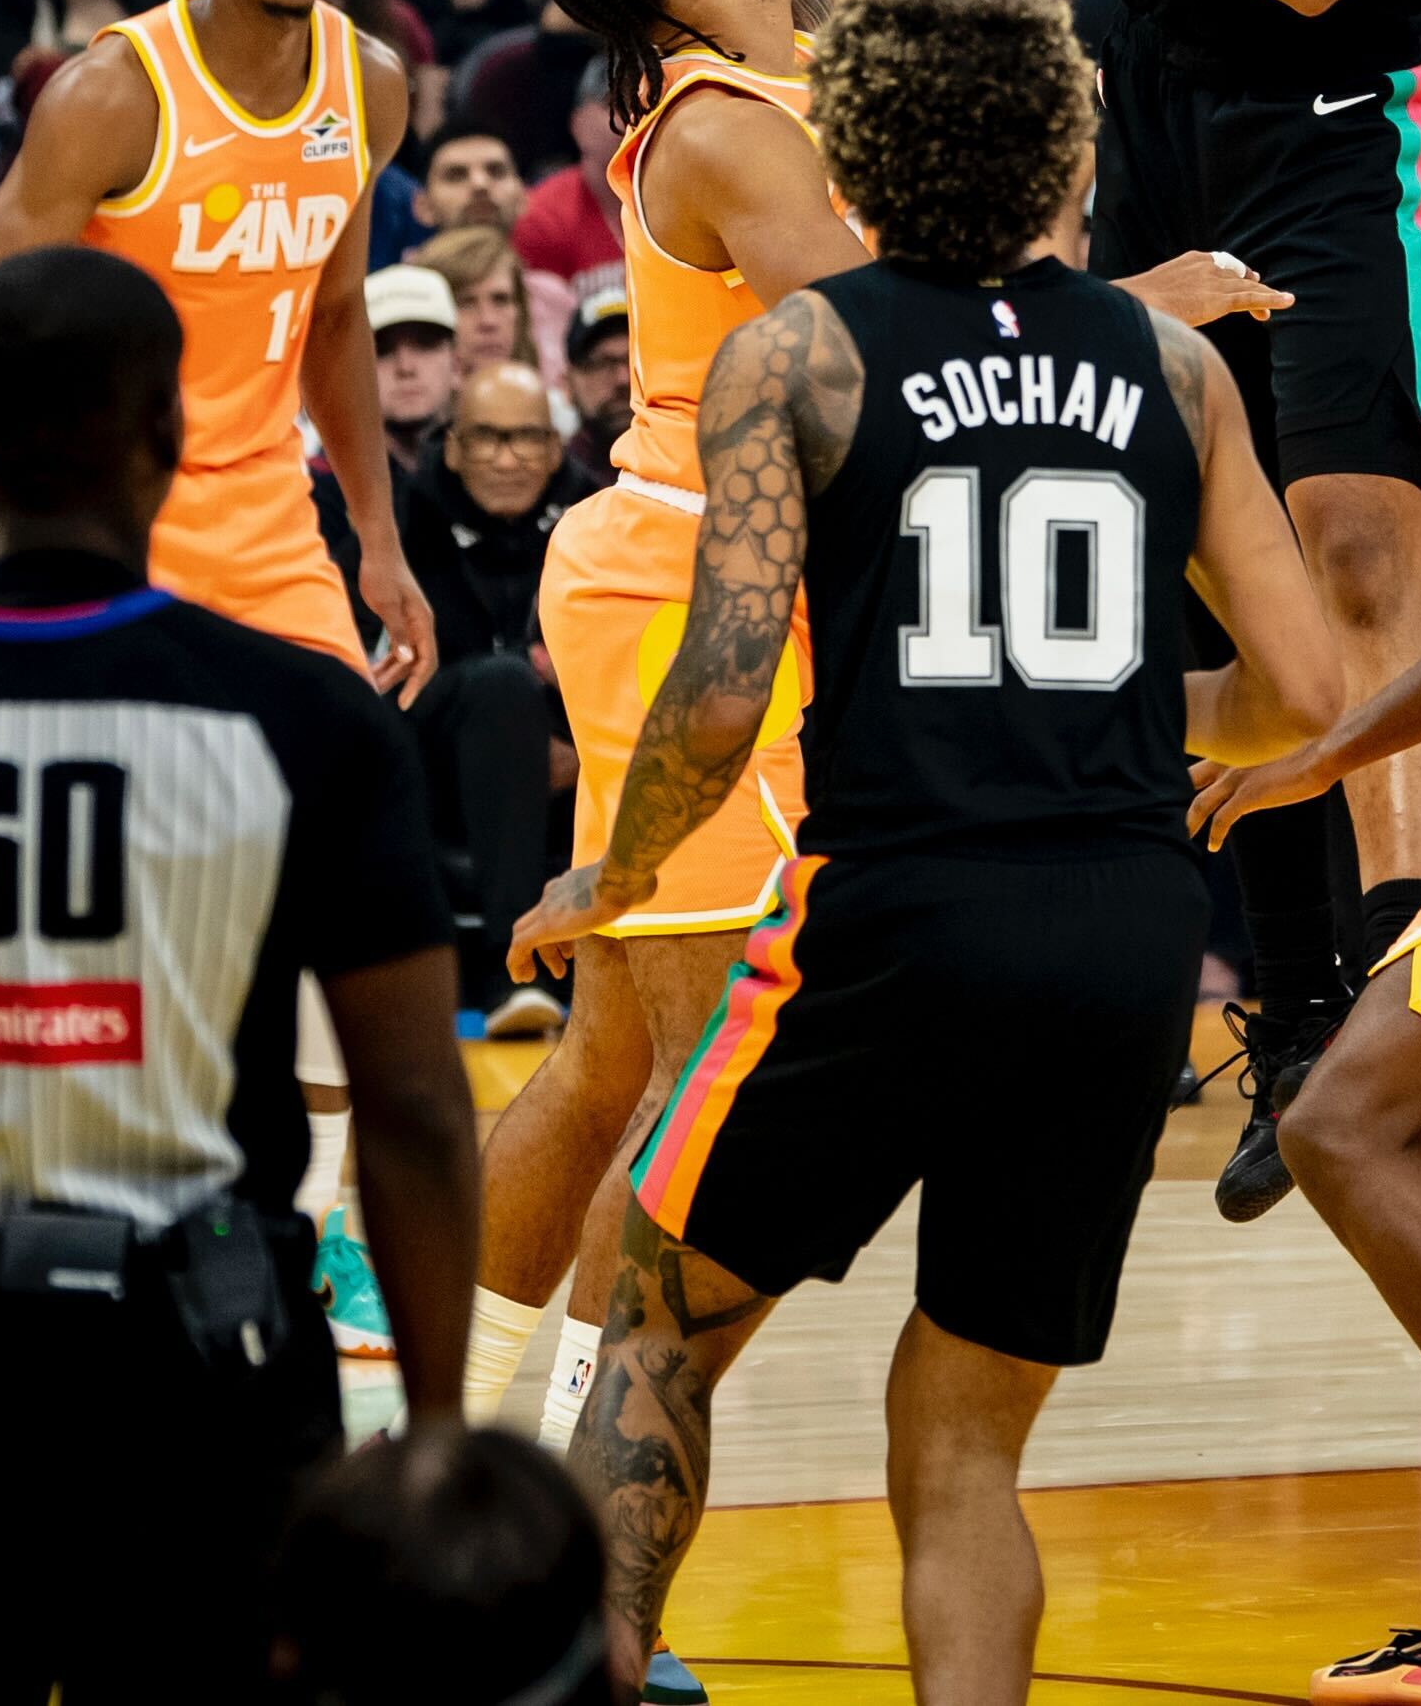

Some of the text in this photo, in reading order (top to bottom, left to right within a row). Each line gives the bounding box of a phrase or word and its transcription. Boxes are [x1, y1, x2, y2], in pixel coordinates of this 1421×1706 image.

[250, 181, 288, 200] THE
[302, 141, 349, 159] CLIFFS
[171, 193, 349, 275] LAND
[901, 355, 1144, 451] SOCHAN
[898, 466, 1147, 692] 10
